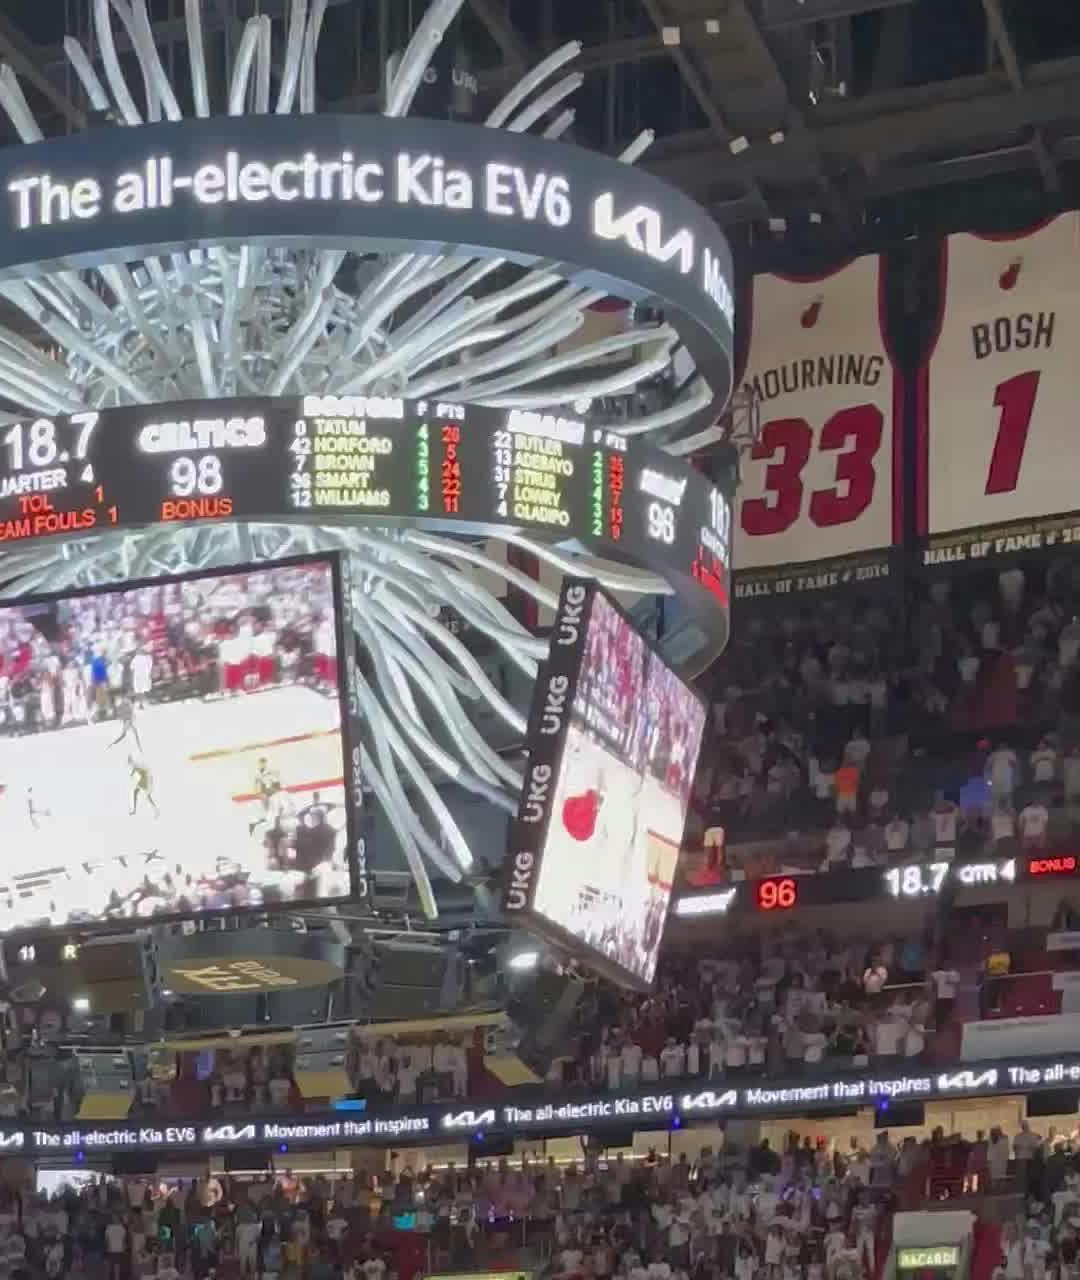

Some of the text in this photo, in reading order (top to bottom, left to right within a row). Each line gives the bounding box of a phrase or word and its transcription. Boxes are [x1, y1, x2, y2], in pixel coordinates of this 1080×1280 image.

[8, 175, 99, 229] The
[113, 152, 382, 213] all-electric
[398, 154, 472, 209] Kia
[486, 162, 572, 226] EV6
[971, 312, 1056, 360] BOSH
[744, 354, 884, 402] MOURNING
[4, 411, 99, 469] 18.7
[137, 416, 266, 453] CELTICS
[295, 419, 307, 436] 0
[314, 419, 367, 436] TATUM
[985, 370, 1041, 496] 1
[290, 437, 393, 455] 42 HORFORD
[81, 464, 94, 483] 4
[171, 455, 223, 496] 98
[295, 455, 306, 471] 7
[315, 455, 375, 472] BROWN
[513, 452, 573, 477] ADEBAYO
[741, 403, 884, 536] 33
[315, 472, 369, 489] SMART
[497, 482, 507, 499] 7
[513, 485, 561, 508] LOWRY
[19, 495, 53, 513] TOL
[95, 486, 104, 503] 1
[161, 498, 232, 521] BONUS
[292, 489, 311, 507] 12
[314, 489, 391, 506] WILLIAMS
[497, 501, 508, 517] 4
[513, 501, 570, 526] OLADIPO
[34, 508, 96, 534] FOULS
[108, 506, 117, 523] 1
[924, 533, 1041, 565] HALL OF FAME
[734, 581, 771, 598] HALL
[775, 579, 792, 594] OF
[797, 572, 838, 591] FAME
[558, 585, 587, 645] UKG
[541, 674, 570, 735] UKG
[523, 764, 551, 823] UKG
[507, 851, 534, 910] UKG
[886, 856, 1077, 896] 18.7 QTR 4 BONUS
[758, 879, 796, 909] 96
[32, 1131, 60, 1146] The
[64, 1128, 136, 1146] all-electric
[139, 1127, 162, 1144] Kia
[166, 1127, 195, 1143] EV6
[264, 1123, 339, 1138] Movement
[344, 1122, 371, 1137] that
[375, 1116, 429, 1137] inspires
[504, 1106, 532, 1123] The
[536, 1101, 611, 1121] all-electric
[614, 1098, 639, 1115] Kia
[642, 1094, 673, 1114] EV6
[747, 1084, 829, 1106] Movement
[834, 1081, 865, 1099] that
[868, 1076, 931, 1100] inspires
[1009, 1066, 1041, 1084] The
